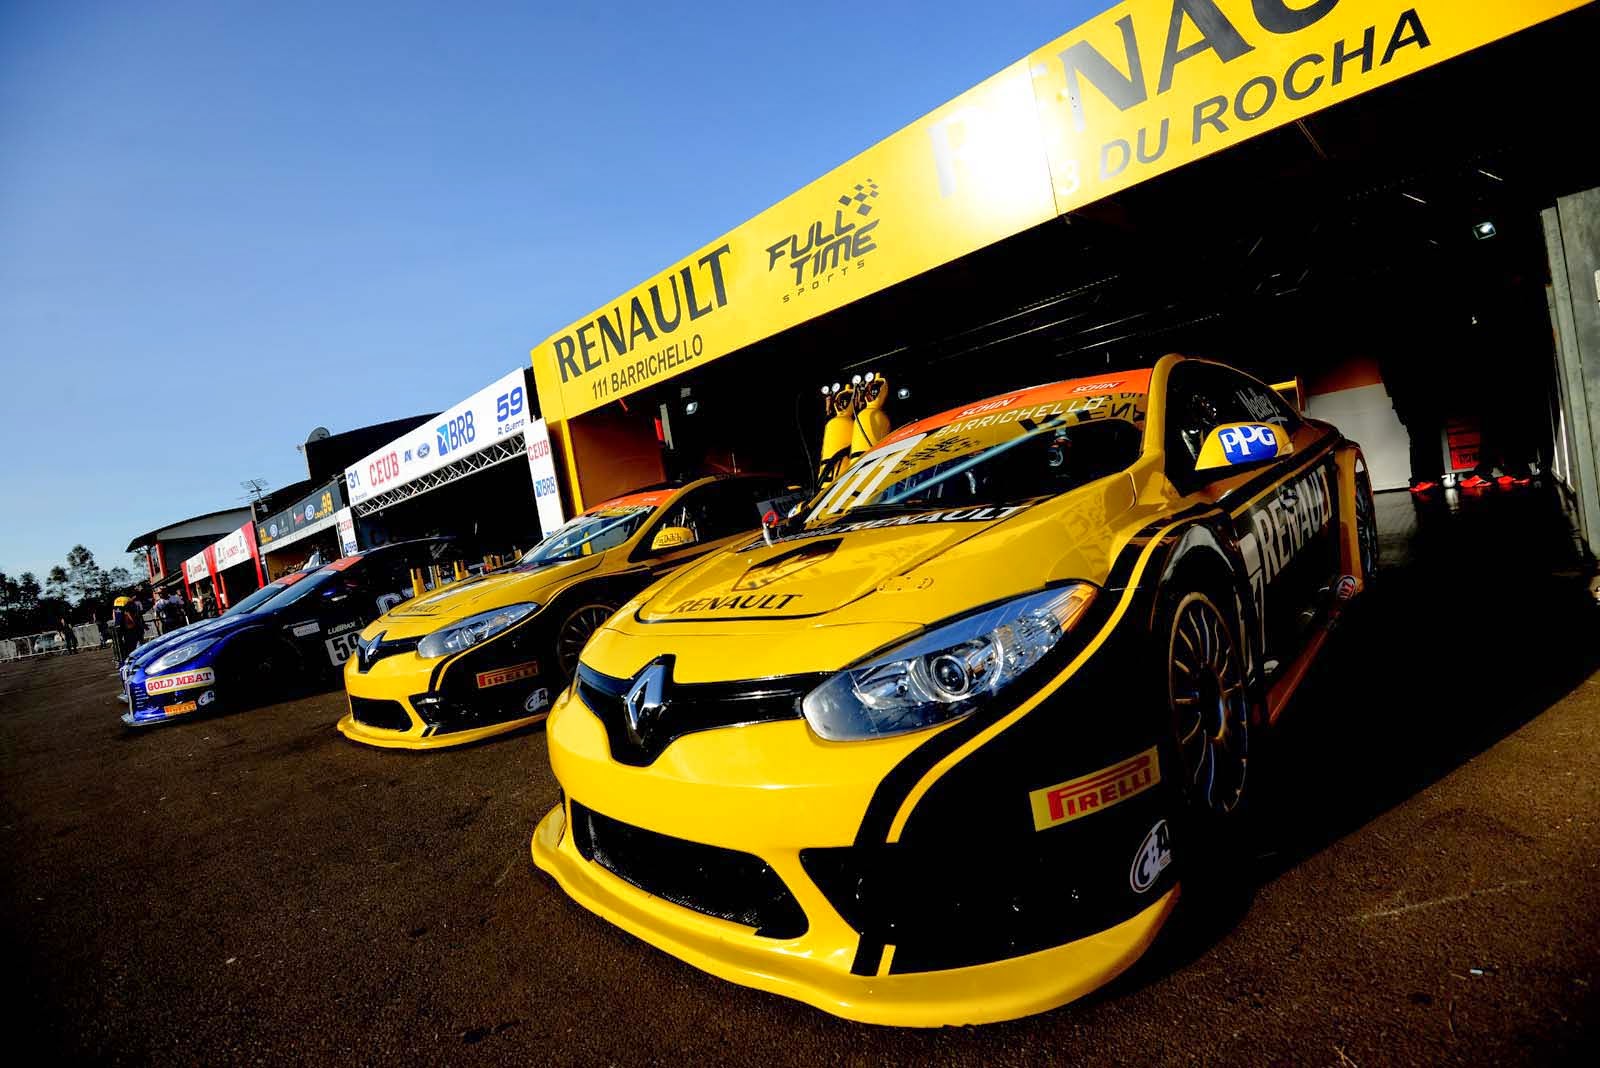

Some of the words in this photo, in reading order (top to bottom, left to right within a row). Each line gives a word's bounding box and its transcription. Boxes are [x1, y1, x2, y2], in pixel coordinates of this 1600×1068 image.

[1099, 118, 1170, 181] DU
[1191, 8, 1431, 145] ROCHA
[765, 209, 855, 272] FULL
[790, 218, 880, 287] TIME
[553, 243, 731, 384] RENAULT
[592, 375, 610, 401] 111
[611, 334, 703, 391] BARRICHELLO
[496, 386, 523, 422] 59
[934, 397, 1105, 438] BARRICHELLO
[957, 398, 1016, 419] SCHIN
[449, 410, 476, 450] BRB
[528, 439, 549, 461] CEUB
[1219, 425, 1276, 456] PPG
[369, 450, 400, 486] CEUB
[543, 476, 556, 496] BRB
[1252, 464, 1333, 585] RENAULT
[671, 593, 804, 614] RENAULT
[147, 678, 174, 691] GOLD
[176, 671, 212, 686] MEAT
[1047, 755, 1153, 821] PIRELLI
